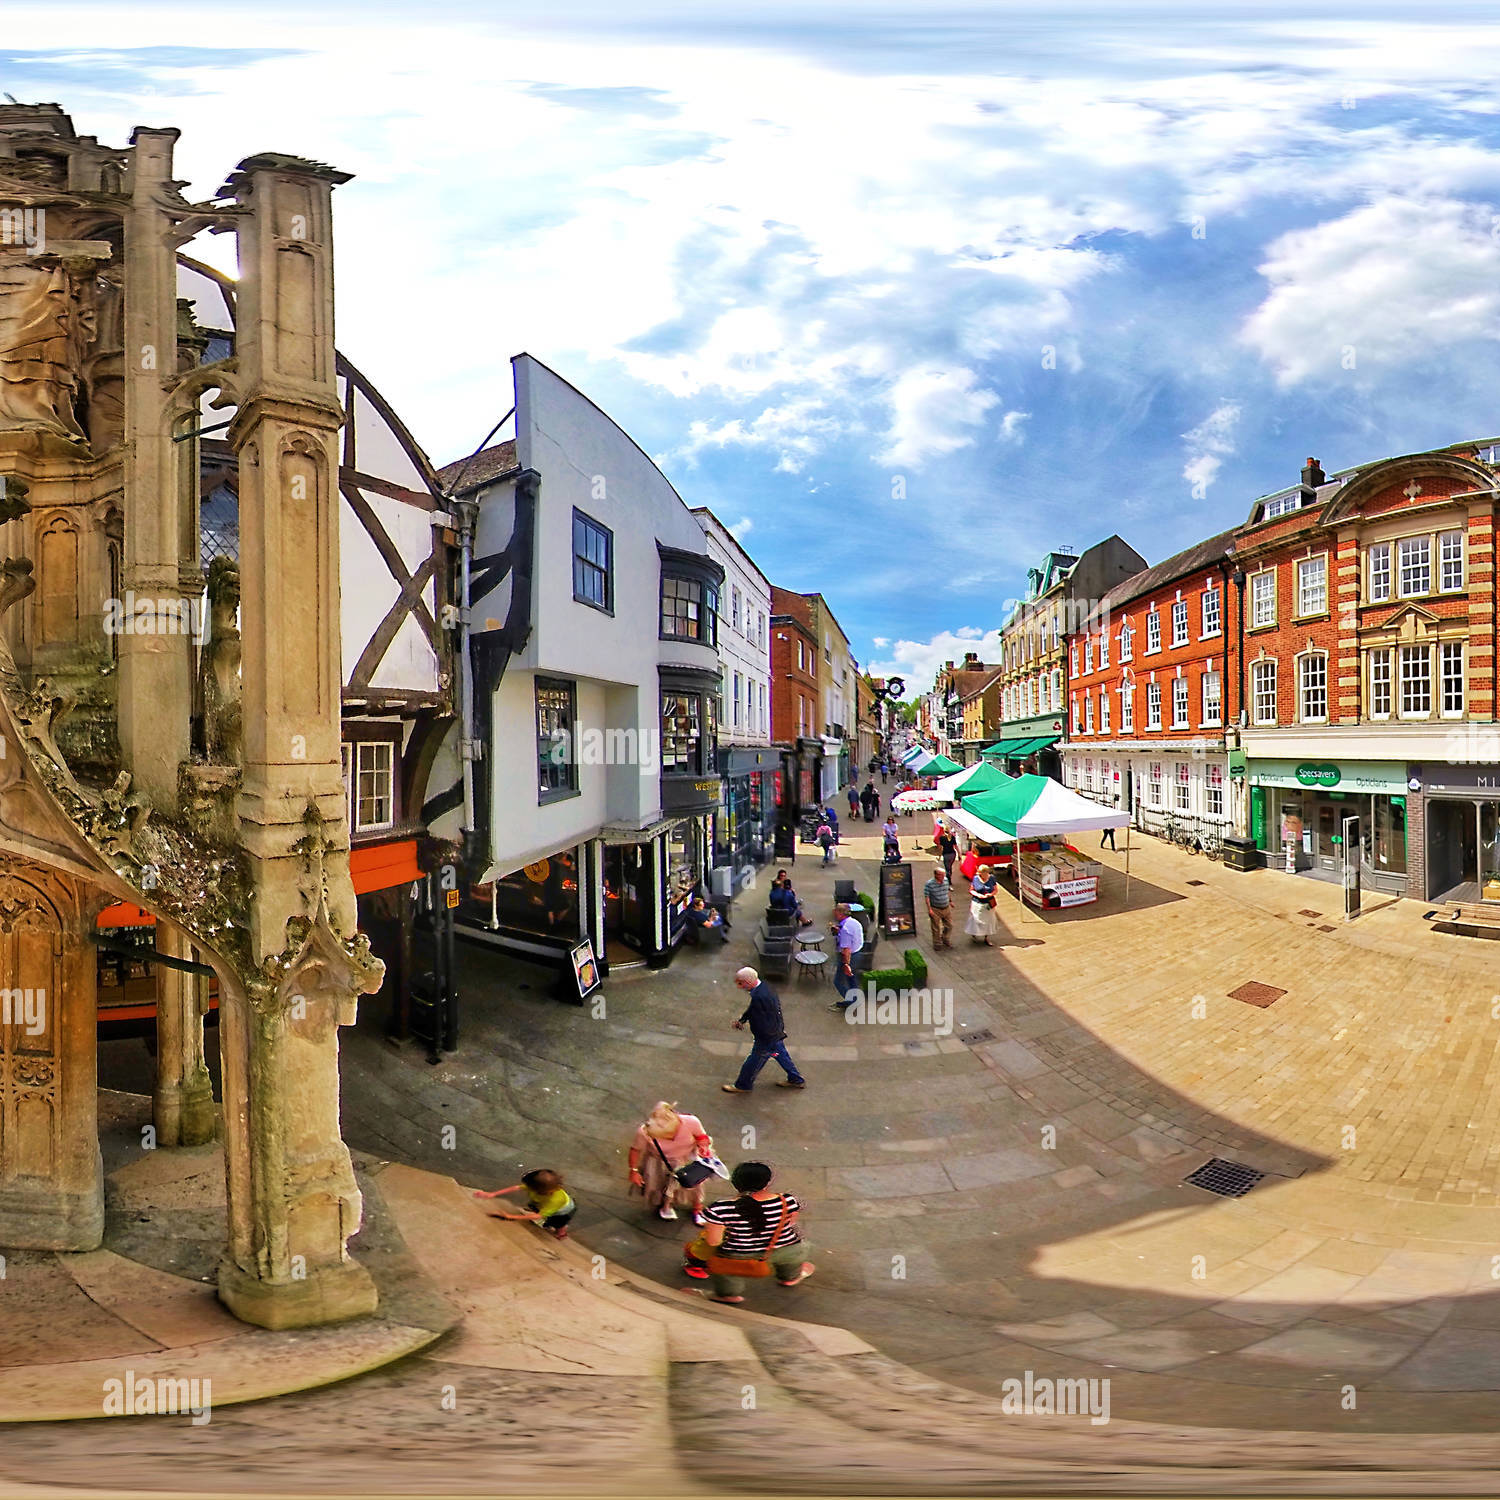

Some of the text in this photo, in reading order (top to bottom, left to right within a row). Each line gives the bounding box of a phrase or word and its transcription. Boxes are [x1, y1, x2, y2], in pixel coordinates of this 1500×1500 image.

[1260, 773, 1284, 783] Opticians
[1300, 768, 1336, 779] Specsavers
[1356, 777, 1388, 788] Opticians
